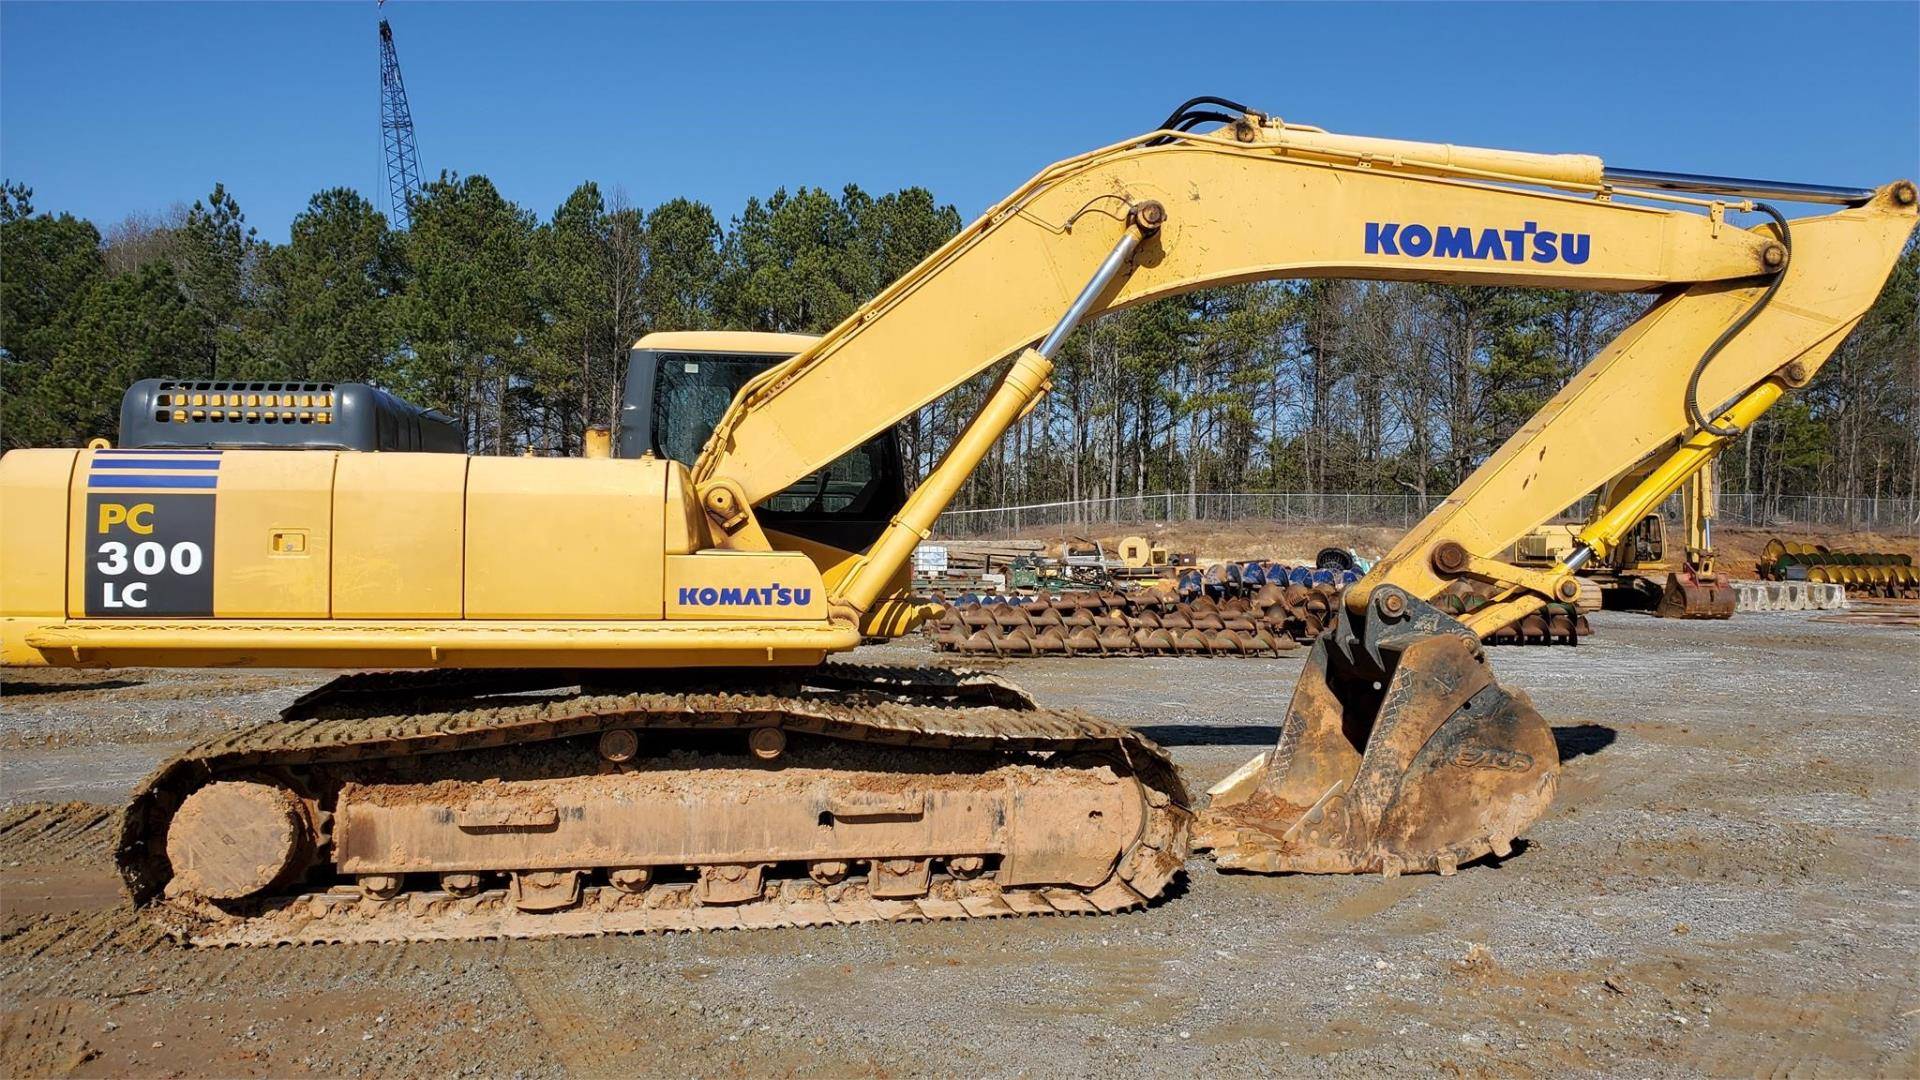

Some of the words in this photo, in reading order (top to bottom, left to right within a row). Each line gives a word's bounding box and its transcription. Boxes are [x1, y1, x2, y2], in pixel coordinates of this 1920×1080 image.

[1365, 221, 1590, 264] KOMATSU
[98, 503, 154, 534] PC
[97, 541, 202, 575] 300
[103, 582, 147, 608] LC
[679, 583, 811, 606] KOMATSU
